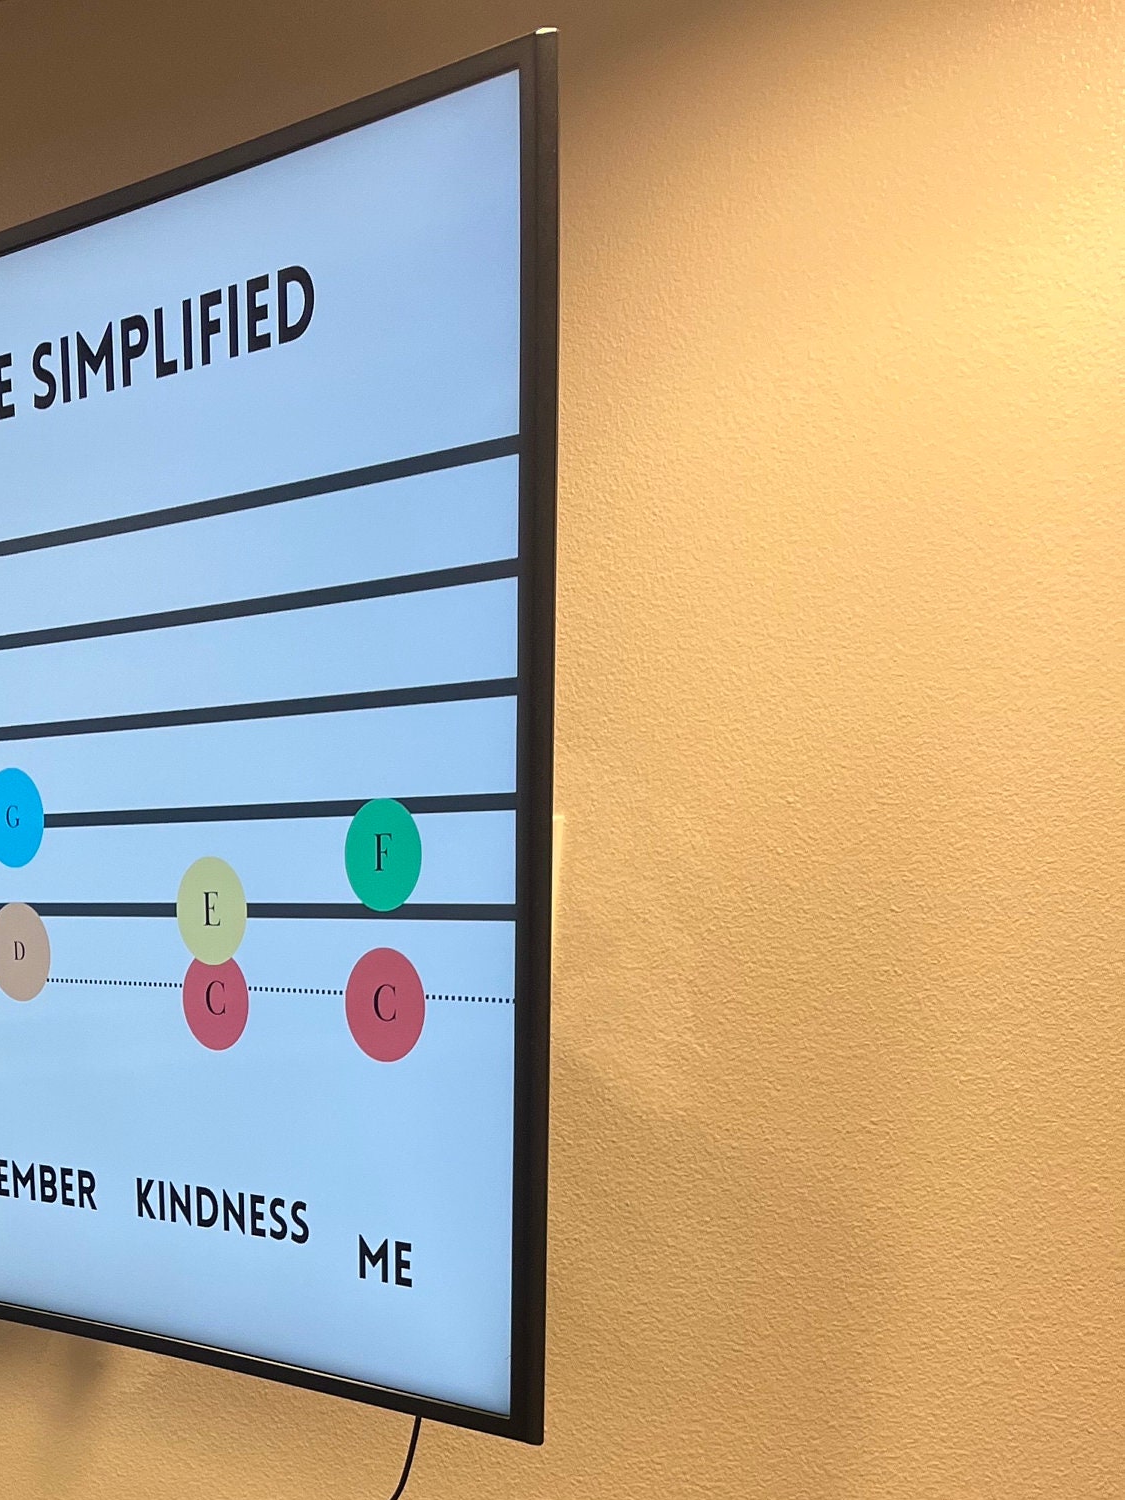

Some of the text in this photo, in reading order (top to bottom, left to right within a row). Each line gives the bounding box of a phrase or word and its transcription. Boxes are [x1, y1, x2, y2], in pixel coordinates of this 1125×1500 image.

[32, 265, 315, 410] SIMPLIFIED
[6, 805, 20, 828] G
[374, 833, 393, 872] F
[203, 891, 222, 927] E
[13, 941, 26, 961] D
[205, 980, 226, 1016] C
[373, 984, 397, 1022] C
[136, 1177, 310, 1244] KINDNESS
[358, 1234, 413, 1288] ME
